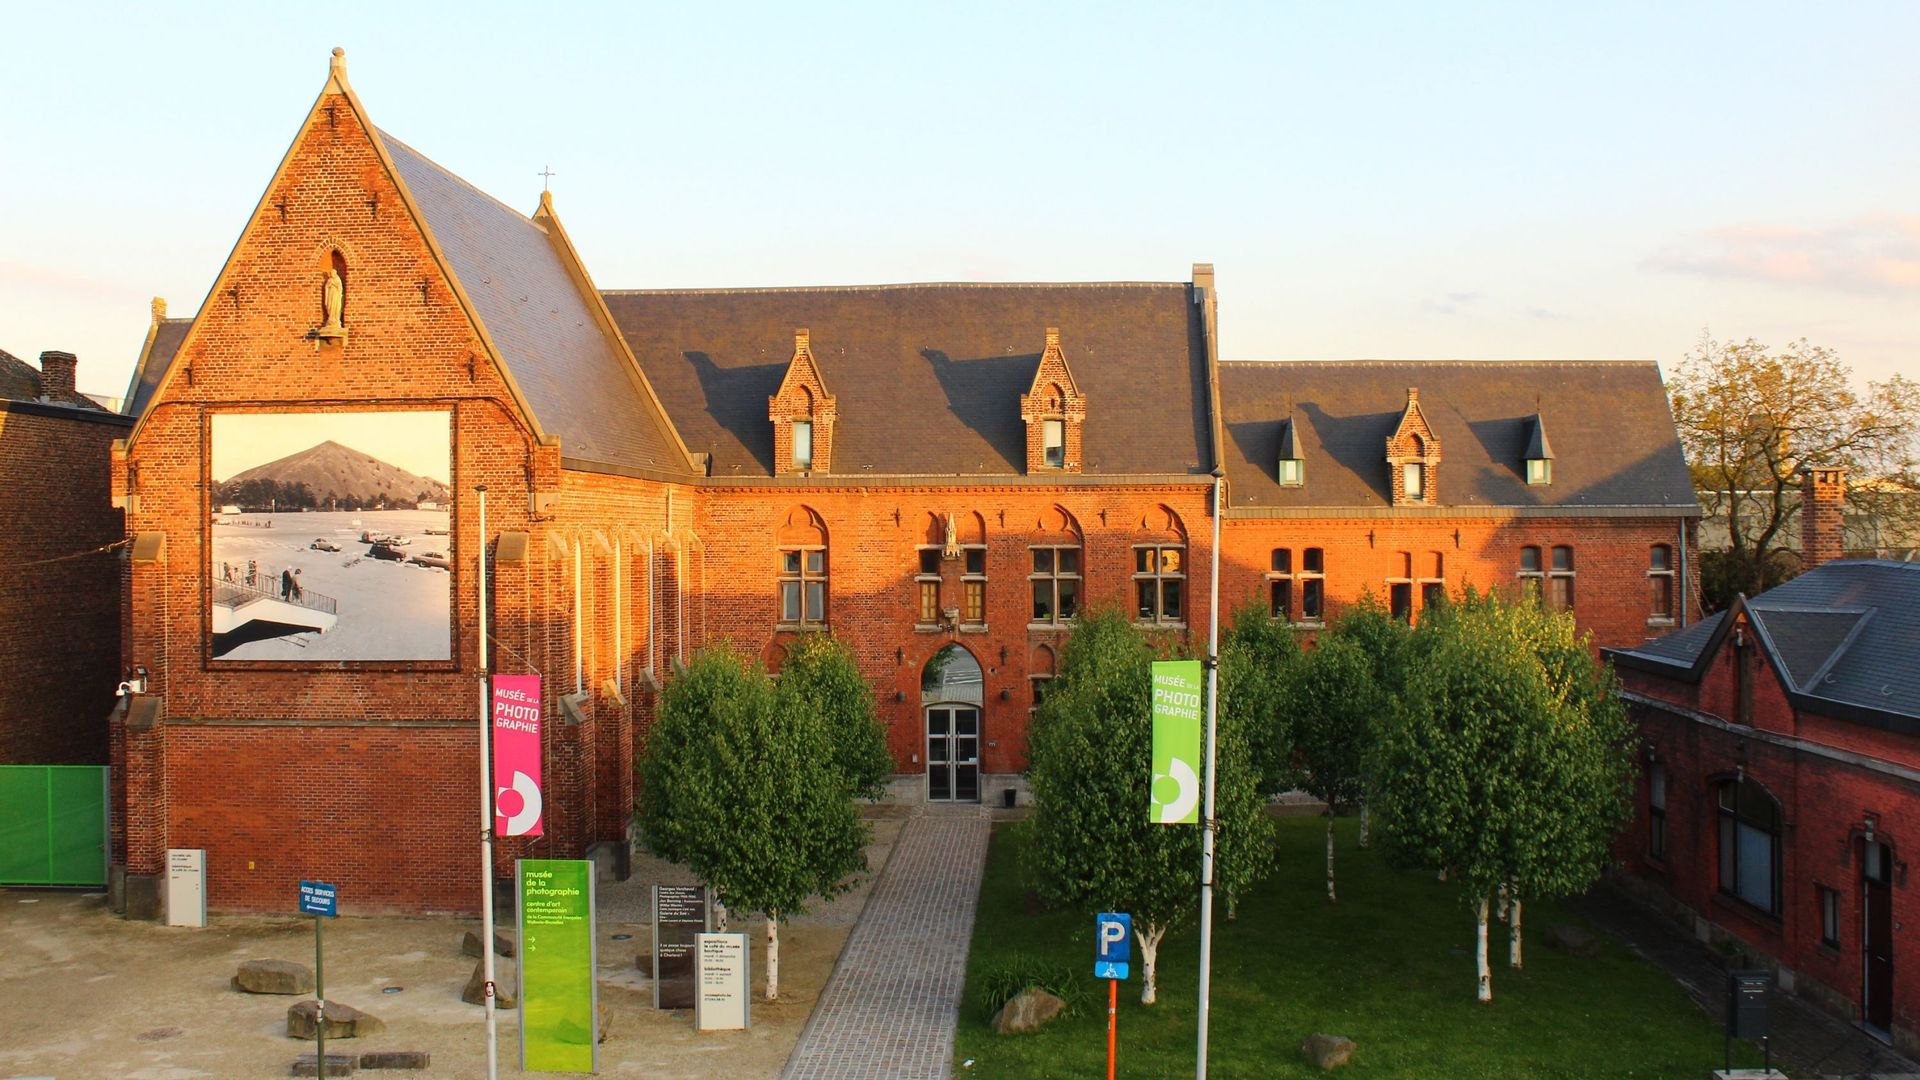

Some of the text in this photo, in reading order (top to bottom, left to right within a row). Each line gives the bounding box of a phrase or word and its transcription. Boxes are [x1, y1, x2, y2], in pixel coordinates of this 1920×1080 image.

[1154, 674, 1186, 688] MUSÉE
[496, 688, 526, 702] MUSÉE
[1154, 688, 1199, 708] PHOTO
[496, 702, 539, 722] PHOTO
[1154, 704, 1198, 720] GRAPHIE
[496, 717, 538, 734] GRAPHIE
[526, 870, 552, 878] musée
[526, 878, 546, 886] de la
[526, 887, 580, 896] photographie
[1101, 921, 1126, 956] P
